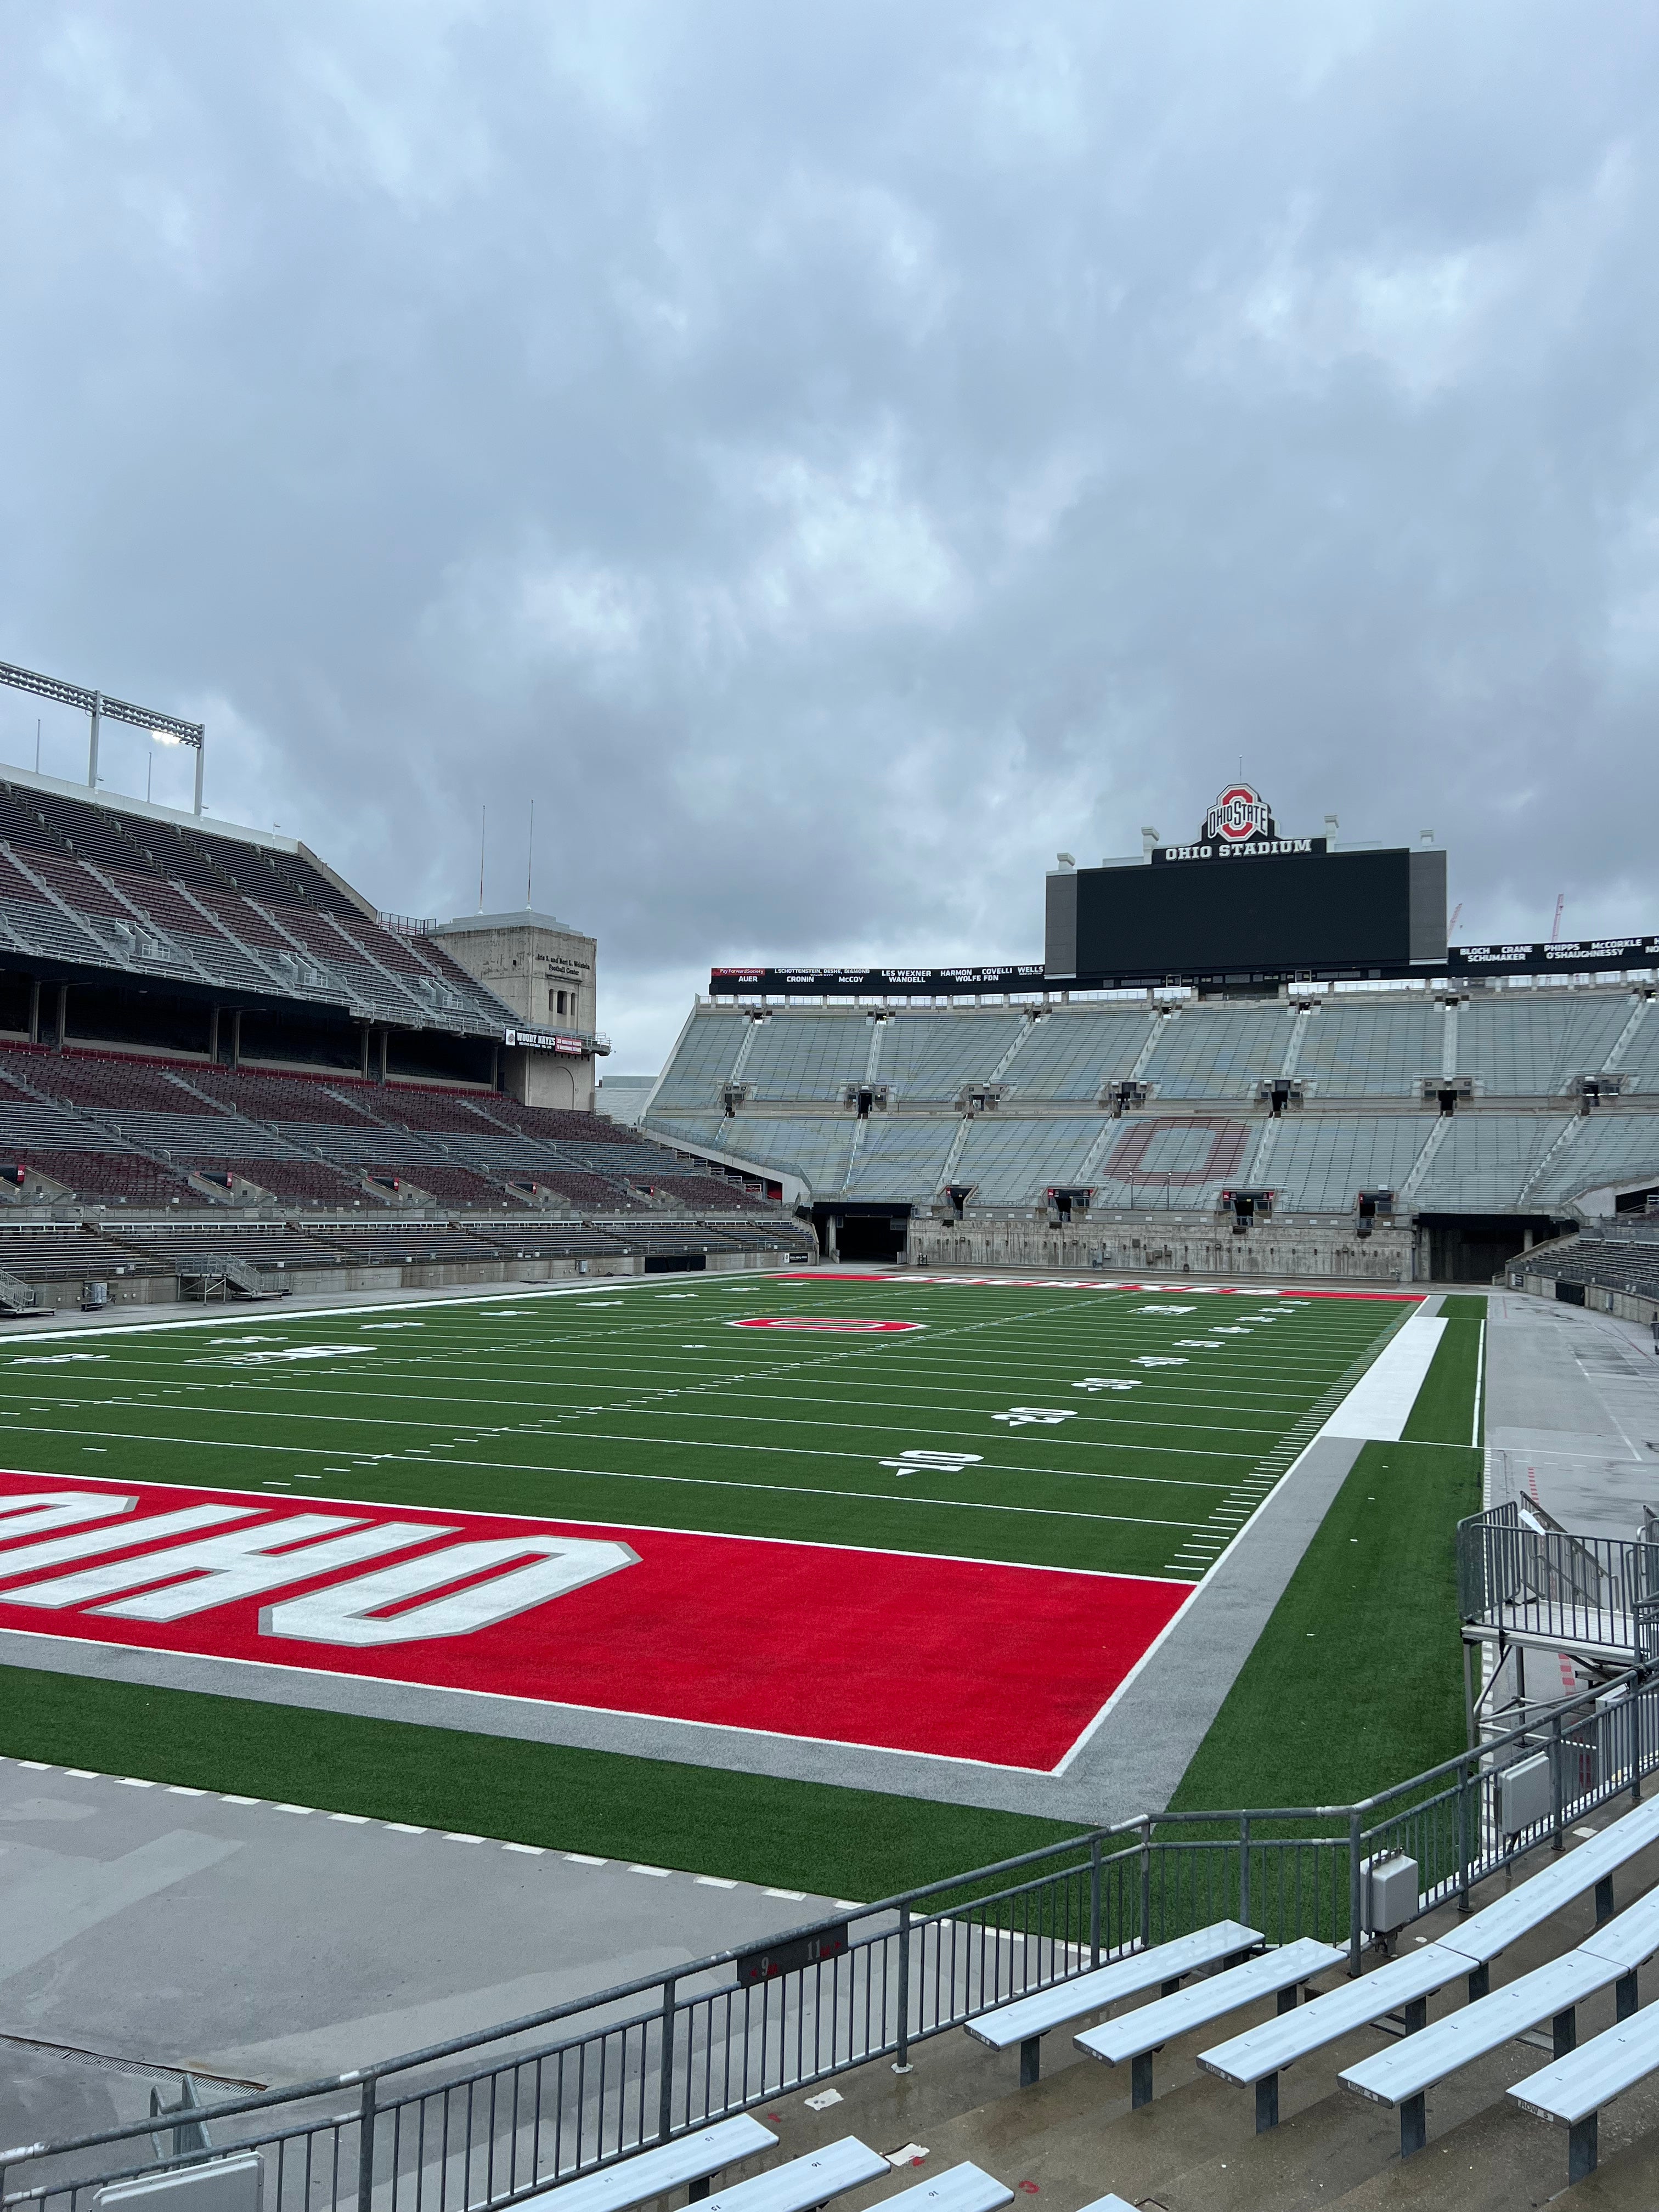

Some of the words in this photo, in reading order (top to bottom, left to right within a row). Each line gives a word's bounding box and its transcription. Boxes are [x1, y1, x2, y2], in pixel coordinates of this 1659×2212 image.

[1210, 805, 1233, 837] OHIO
[1234, 800, 1266, 833] STATE
[1165, 845, 1212, 861] OHIO
[1219, 839, 1312, 857] STADIUM
[1501, 945, 1533, 953] CRANE
[1544, 944, 1580, 952] PHIPPS
[1591, 939, 1642, 950] McCORKLE
[1468, 953, 1526, 962] SCHUMAKER
[1546, 948, 1624, 959] O'SHAUGHNESSY
[549, 964, 565, 973] Football
[566, 967, 579, 975] Center
[516, 1032, 537, 1043] WOODY
[537, 1035, 556, 1046] HAYES
[878, 1450, 984, 1472] 10
[1350, 2082, 1365, 2095] ROW
[1520, 2101, 1539, 2114] ROW
